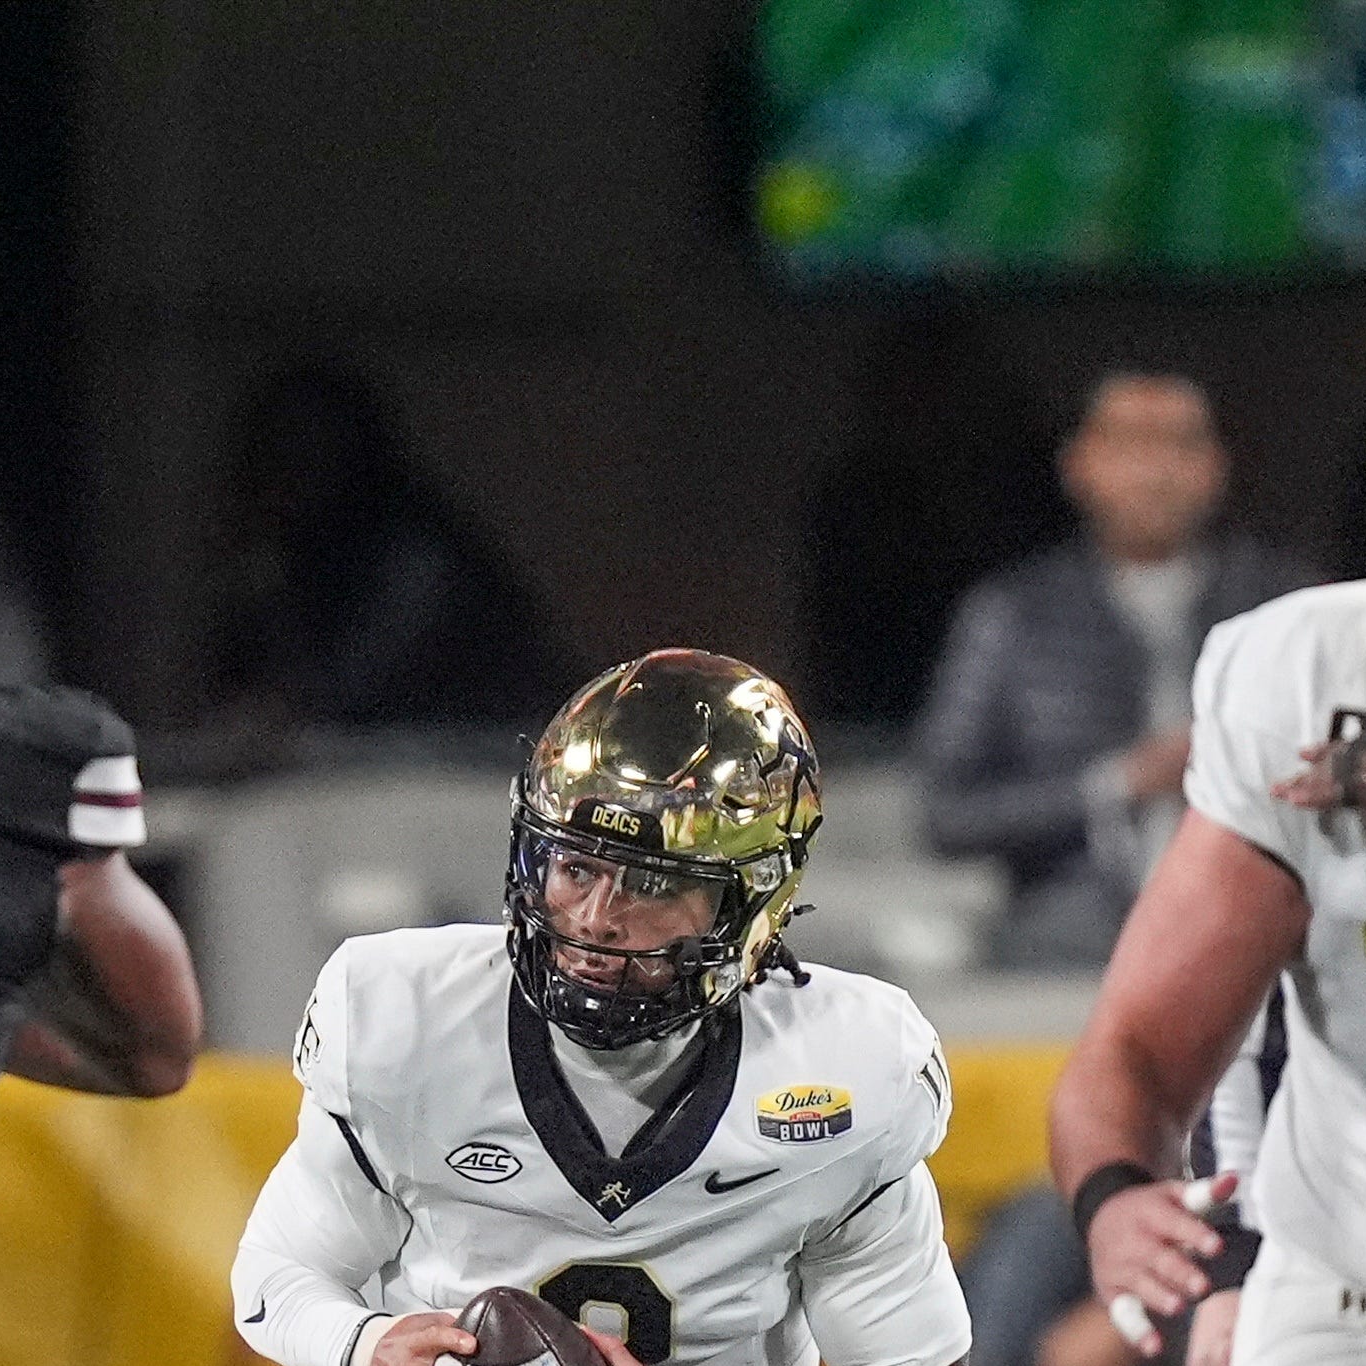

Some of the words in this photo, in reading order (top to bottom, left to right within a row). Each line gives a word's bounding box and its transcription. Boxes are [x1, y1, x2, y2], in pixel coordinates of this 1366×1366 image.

[592, 805, 641, 837] DEACS
[776, 1089, 833, 1112] Duke's
[779, 1120, 835, 1141] BOWL
[457, 1152, 512, 1170] ACC
